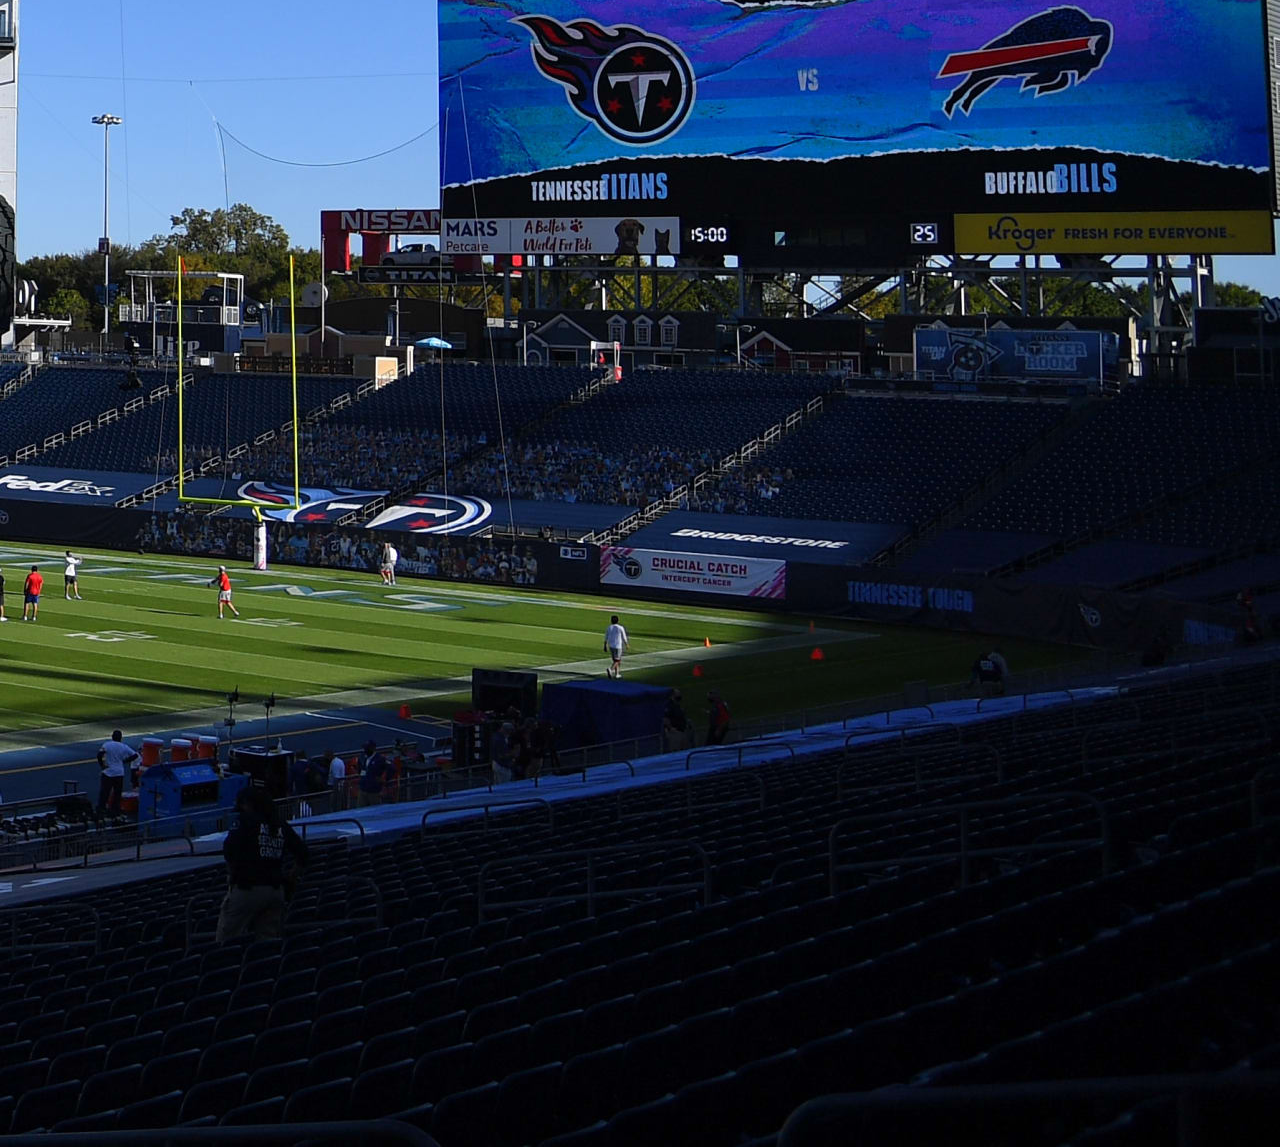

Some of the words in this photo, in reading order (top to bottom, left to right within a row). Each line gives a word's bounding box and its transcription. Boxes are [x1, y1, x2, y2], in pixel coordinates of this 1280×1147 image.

[797, 68, 820, 92] VS
[601, 172, 668, 201] TITANS
[985, 171, 1057, 195] BUFFALO
[1053, 163, 1118, 193] BILLS
[446, 220, 498, 238] MARS
[524, 220, 534, 234] A
[536, 219, 567, 235] Better
[691, 226, 727, 242] 15:00
[913, 224, 936, 241] 25
[988, 217, 1056, 251] Kroger
[1064, 228, 1109, 240] FRESH
[1113, 227, 1145, 240] FOR
[446, 240, 490, 252] Petcare
[523, 237, 557, 252] World
[574, 237, 593, 251] Pets
[388, 270, 452, 281] TITAN
[670, 528, 849, 549] BRIDGESTONE
[651, 557, 704, 572] CRUCIAL
[707, 560, 748, 575] CATCH
[661, 574, 702, 585] INTERCEPT
[702, 577, 732, 587] CANCER
[847, 581, 924, 609] TENNESSEE
[927, 587, 974, 613] TOUGH
